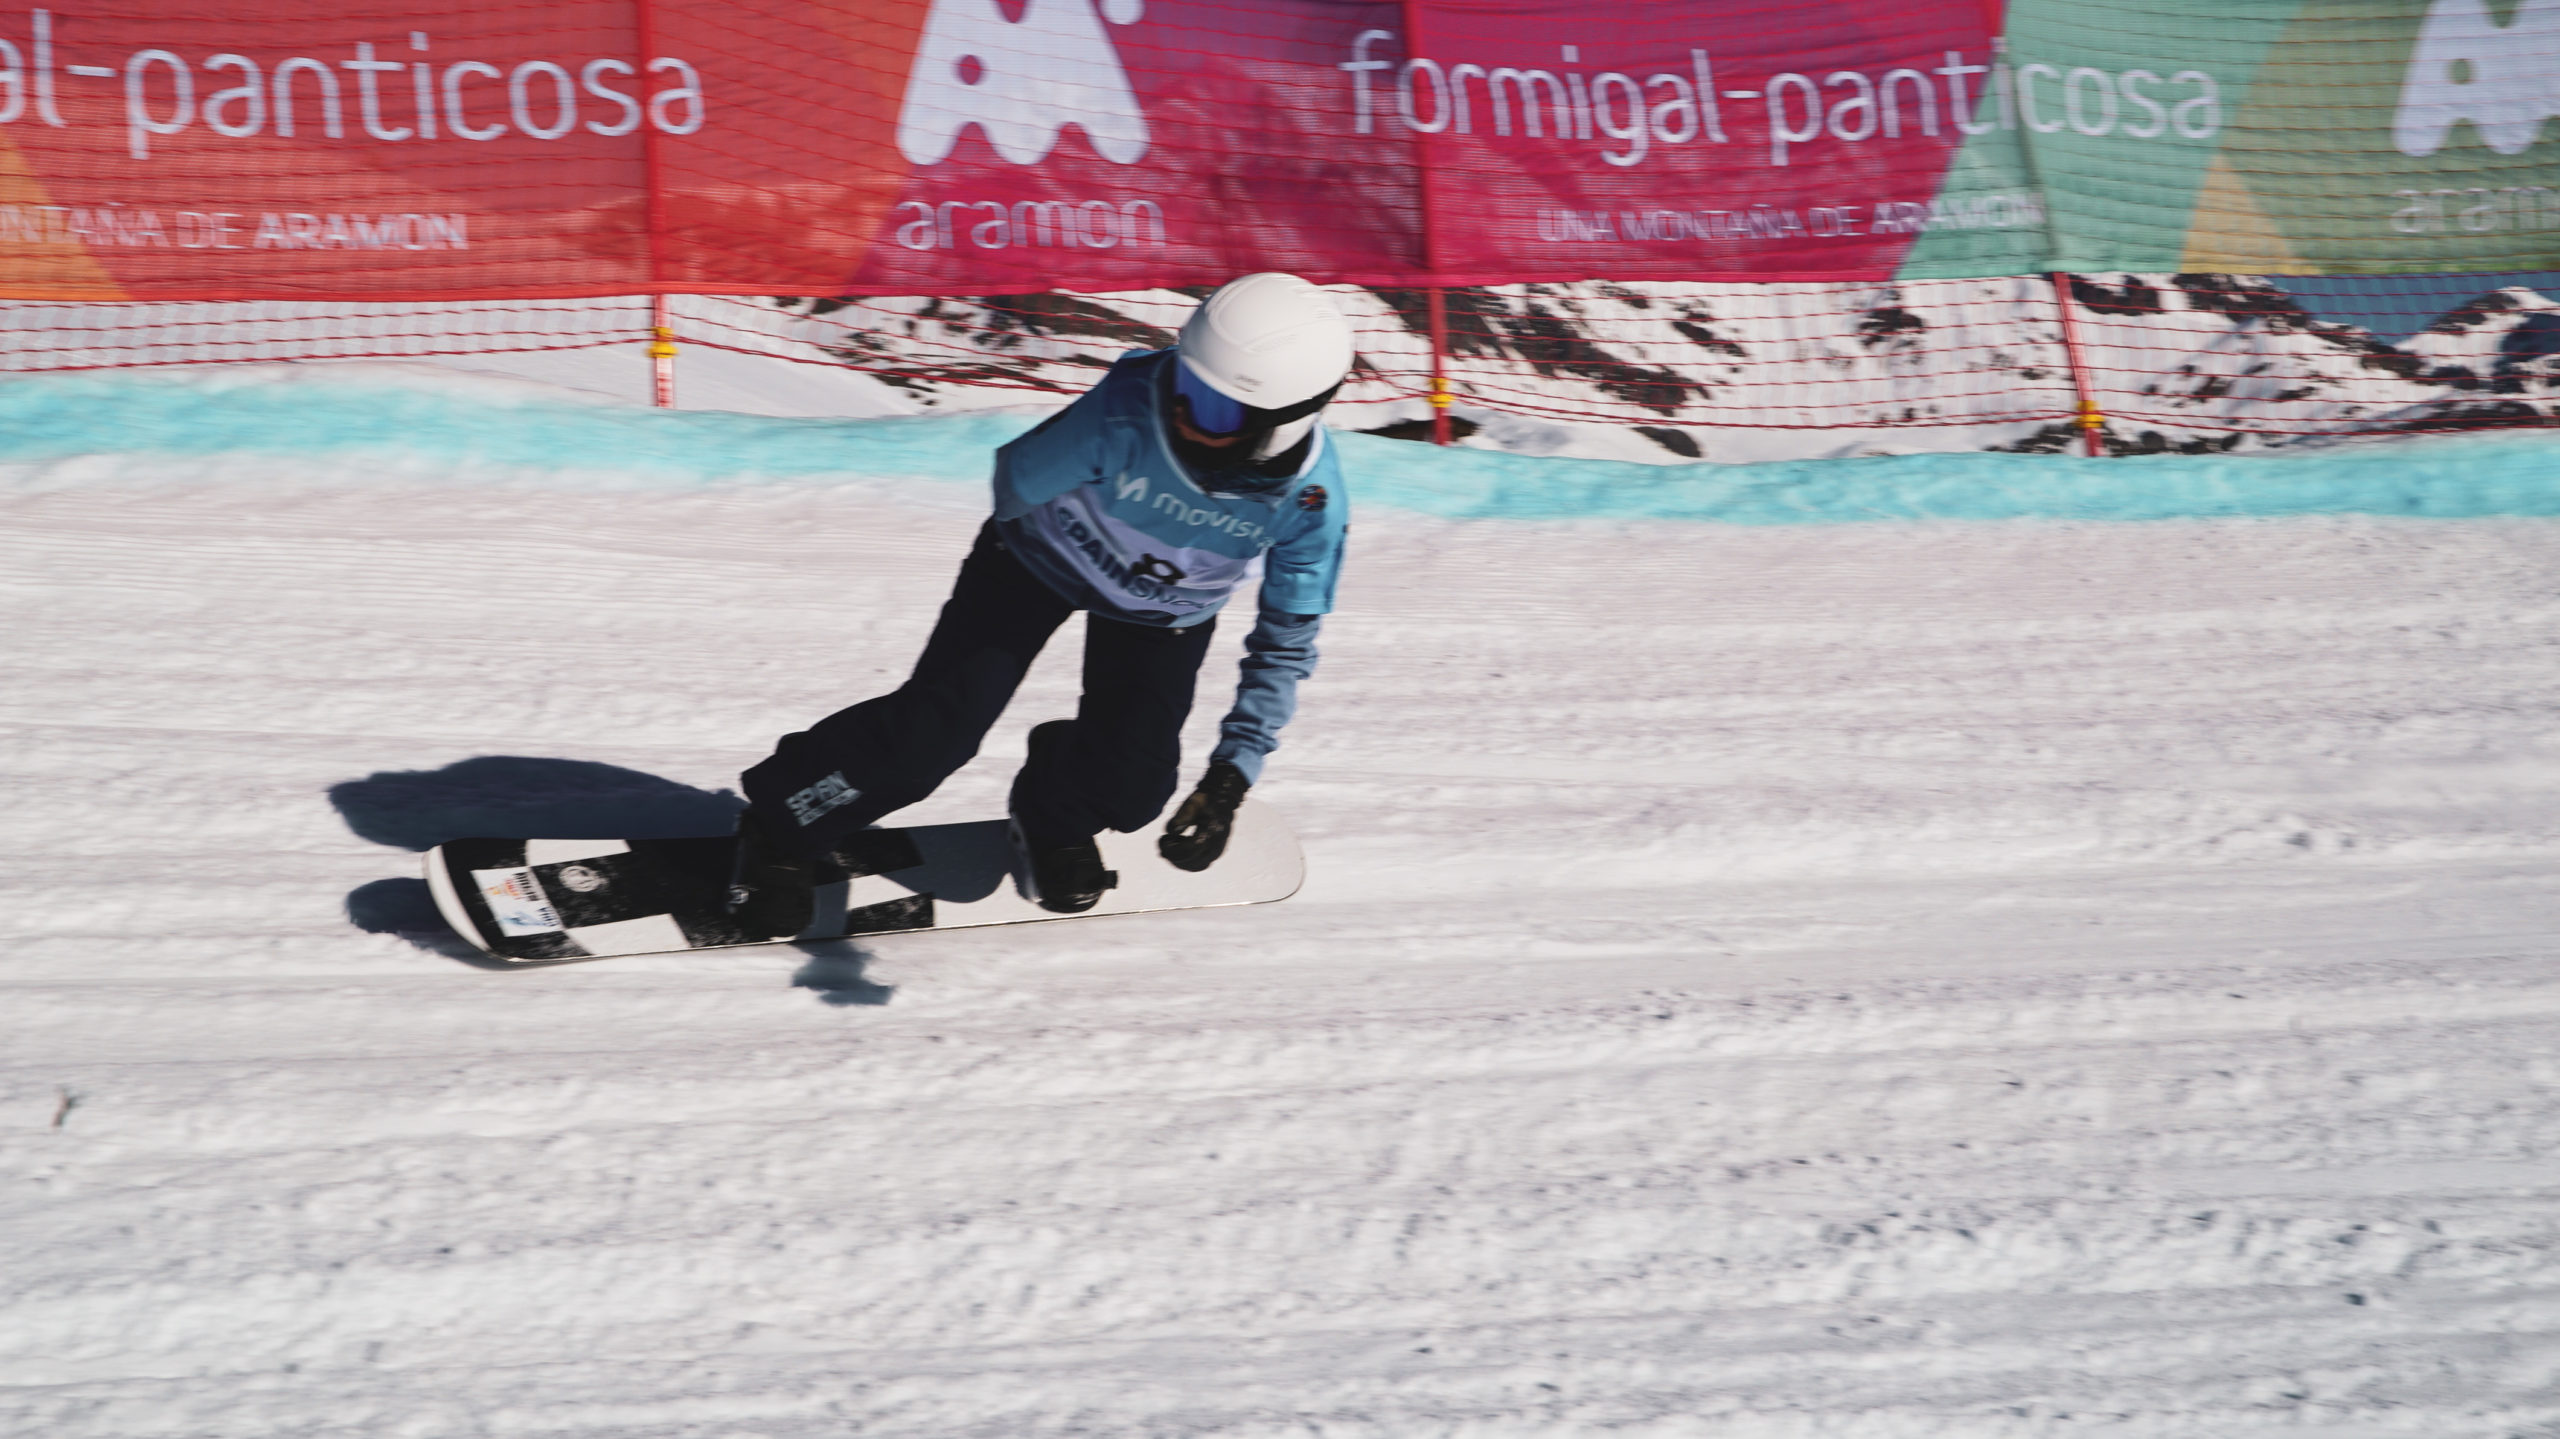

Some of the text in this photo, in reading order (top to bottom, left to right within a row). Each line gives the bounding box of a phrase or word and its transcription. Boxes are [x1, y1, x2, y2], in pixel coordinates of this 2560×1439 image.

[1340, 29, 2222, 167] formigal-panticosa
[176, 211, 245, 249] DE
[253, 212, 470, 250] ARAMON
[896, 200, 1166, 250] aramon
[1537, 194, 2045, 241] UNA MONTAÑA DE ARAMON
